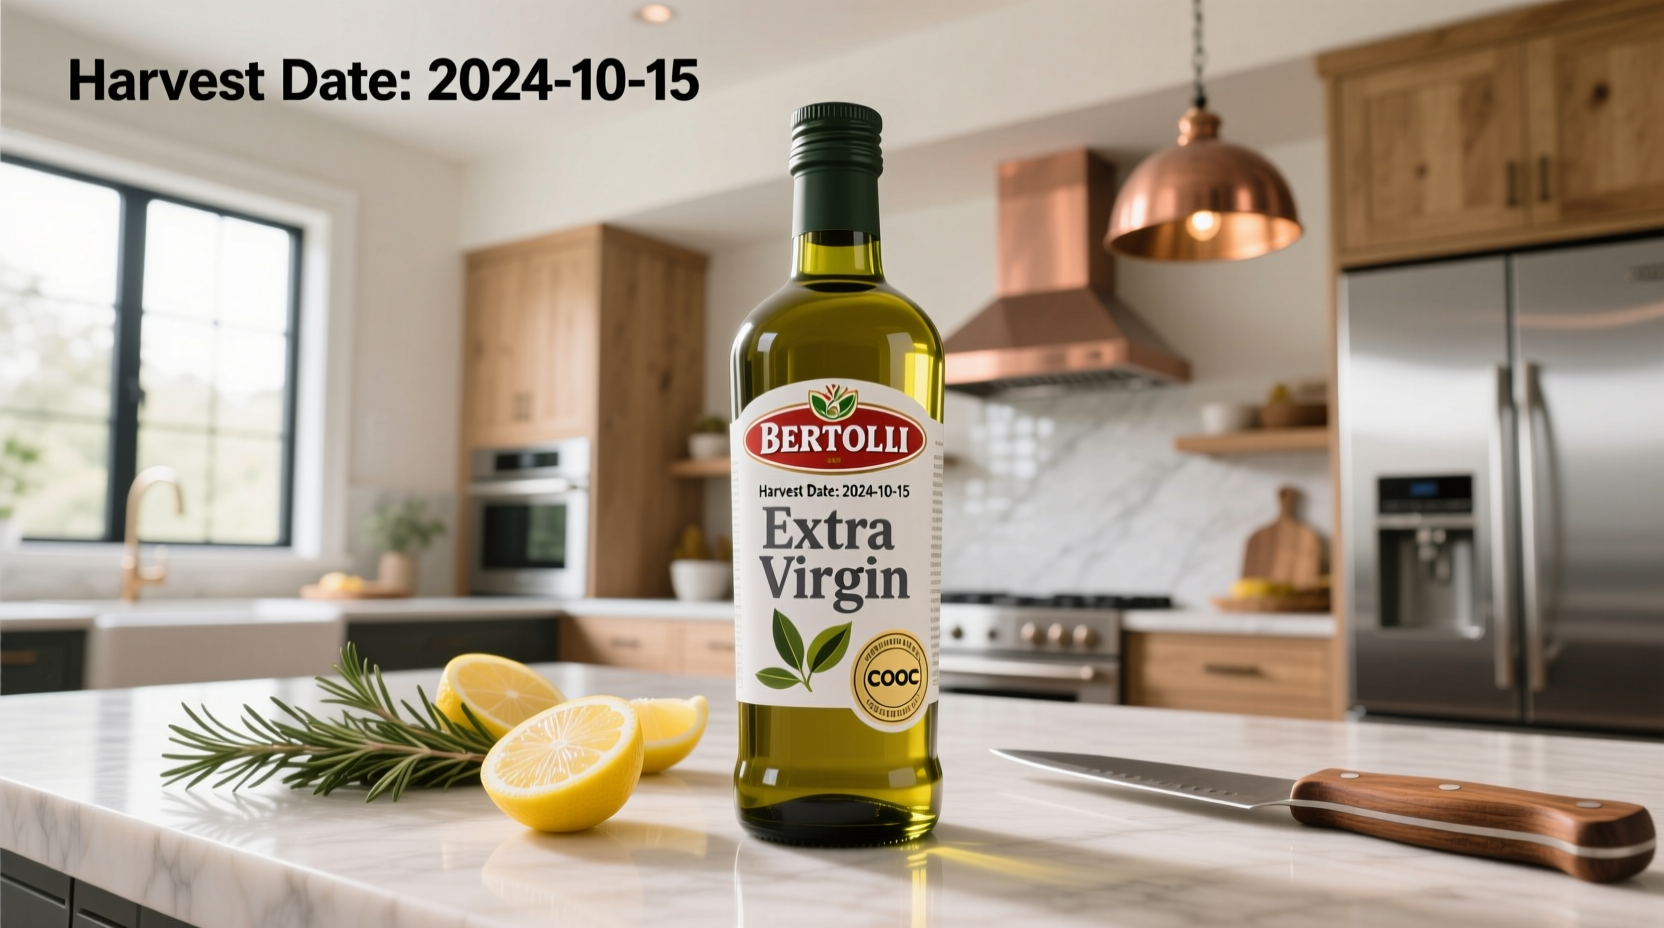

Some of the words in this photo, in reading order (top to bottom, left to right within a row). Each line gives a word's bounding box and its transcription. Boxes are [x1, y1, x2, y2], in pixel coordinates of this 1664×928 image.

[760, 421, 909, 455] BERTOLLI
[759, 484, 804, 498] Harvest
[806, 484, 840, 498] Date:
[842, 484, 910, 498] 2024-10-15
[762, 506, 895, 550] Extra
[759, 555, 910, 614] Virgin
[867, 668, 920, 687] COOC
